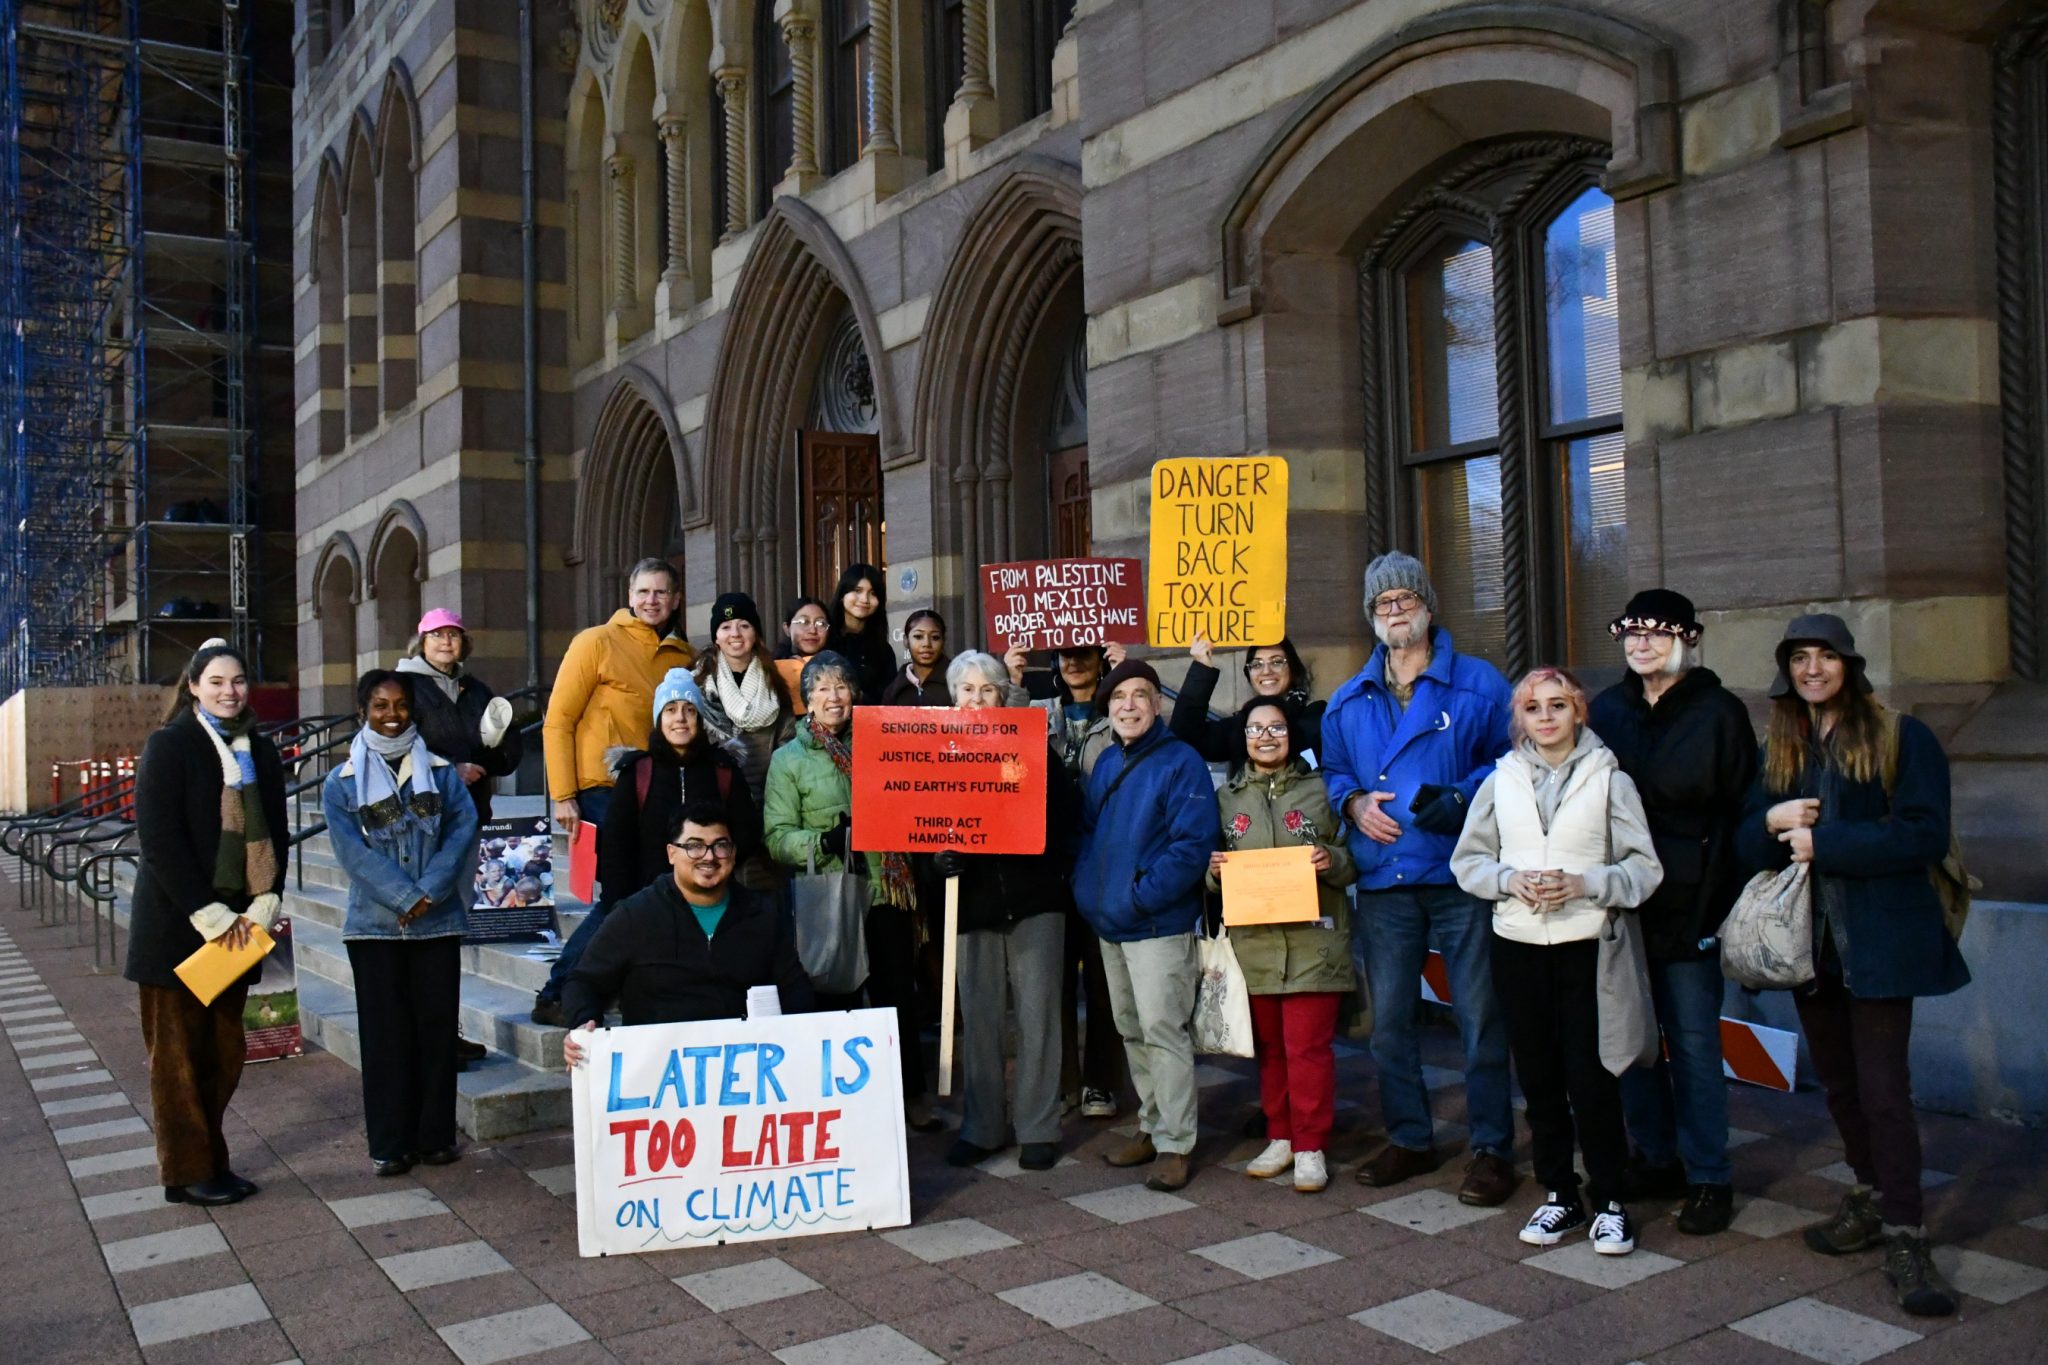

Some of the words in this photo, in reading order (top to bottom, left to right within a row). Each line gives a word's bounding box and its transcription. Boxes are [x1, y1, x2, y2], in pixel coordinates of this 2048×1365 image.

[1160, 463, 1270, 499] DANGER
[1175, 501, 1254, 536] TURN
[1177, 540, 1251, 577] BACK
[989, 568, 1029, 593] FROM
[1035, 563, 1127, 588] PALESTINE
[1005, 594, 1027, 615] TO
[1034, 586, 1108, 612] MEXICO
[1164, 580, 1248, 608] TOXIC
[994, 612, 1047, 635] BORDER
[1052, 608, 1098, 626] WALLS
[1101, 607, 1138, 626] HAVE
[1156, 610, 1255, 644] FUTURE
[1008, 630, 1036, 649] GOT
[1041, 628, 1064, 648] TO
[1072, 626, 1105, 646] GO!
[881, 722, 937, 735] SENIORS
[941, 723, 988, 735] UNITED
[992, 724, 1018, 735] FOR
[879, 751, 935, 764] JUSTICE,
[938, 752, 1020, 765] DEMOCRACY,
[884, 780, 911, 792] AND
[914, 780, 967, 792] EARTH'S
[970, 781, 1020, 793] FUTURE
[914, 816, 953, 828] THIRD
[956, 817, 982, 828] ACT
[908, 833, 967, 845] HAMDEN,
[970, 833, 988, 845] CT
[607, 1043, 788, 1112] LATER
[821, 1036, 874, 1097] IS
[609, 1117, 696, 1177] TOO
[721, 1109, 842, 1167] LATE
[615, 1198, 660, 1228] ON
[685, 1168, 856, 1221] CLIMATE
